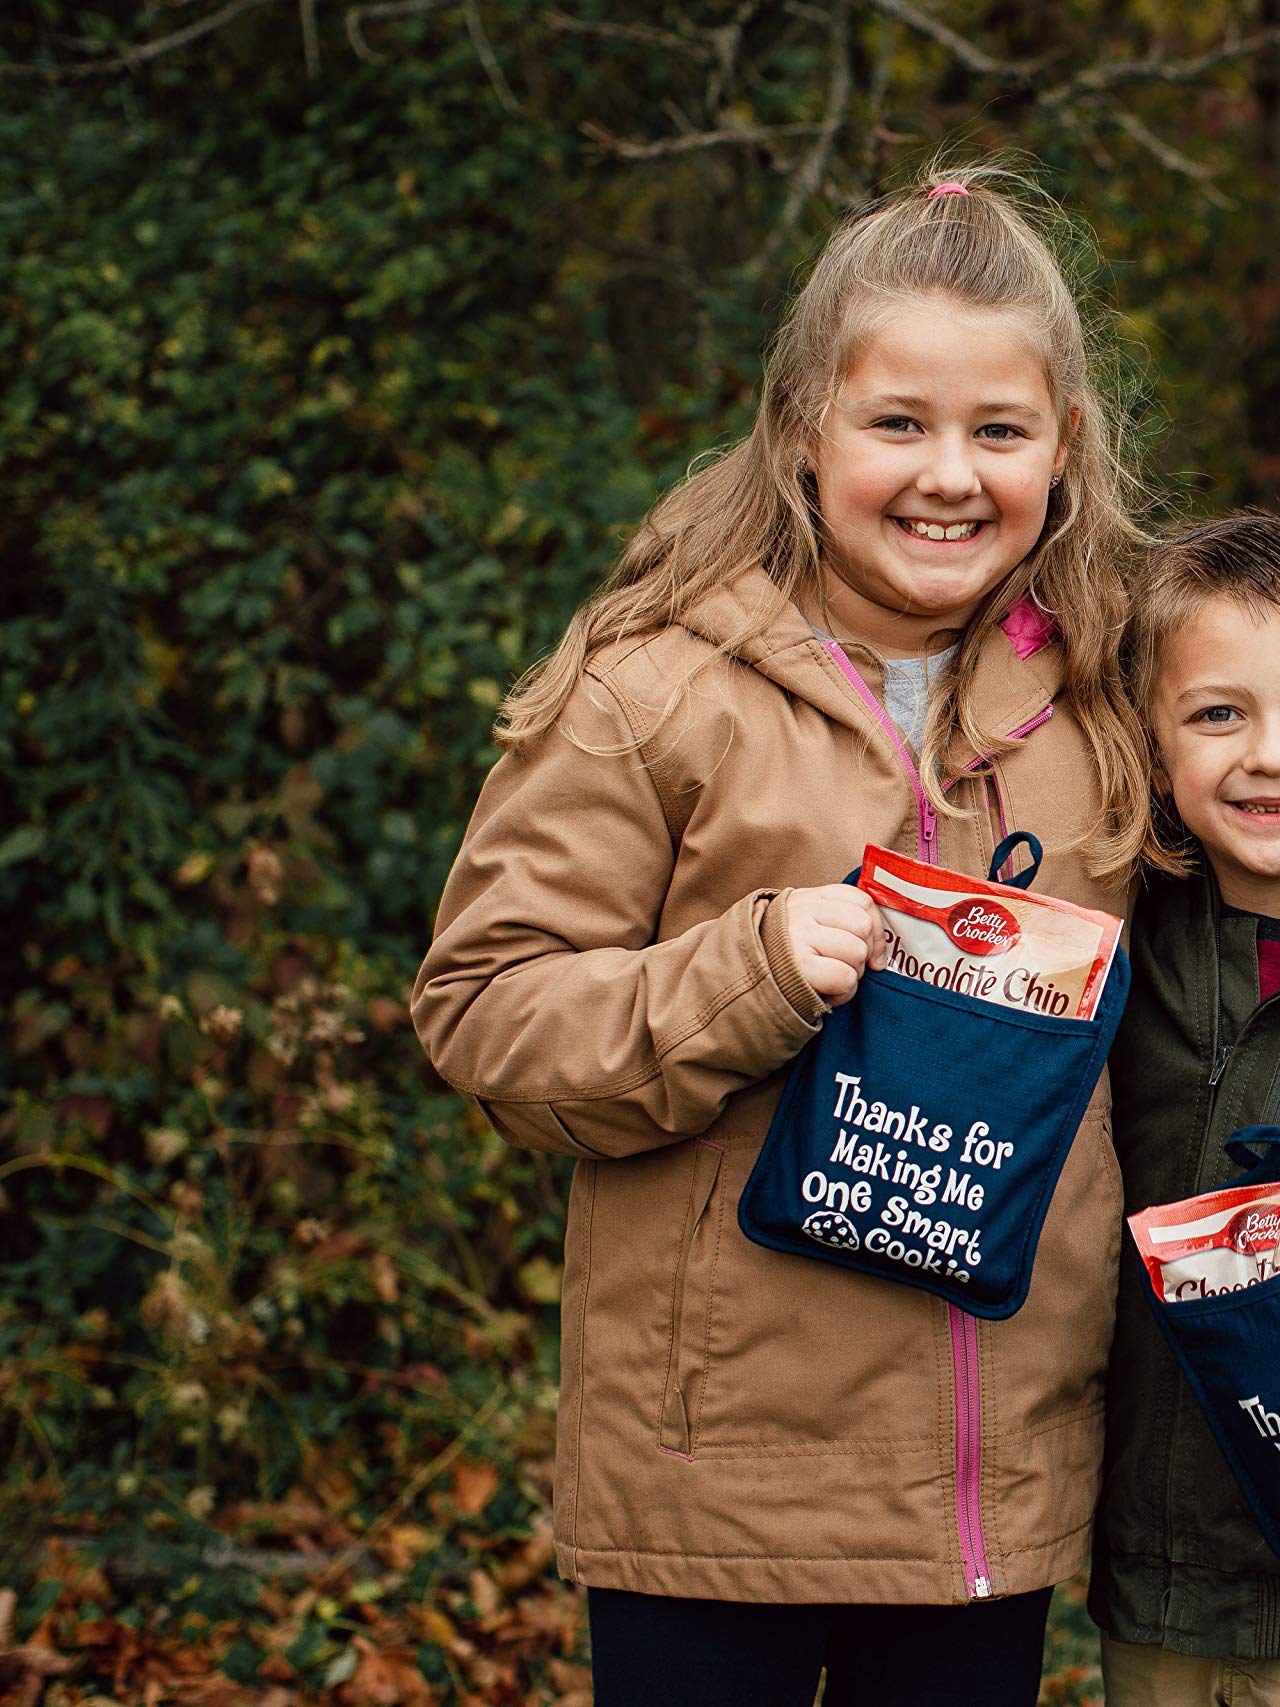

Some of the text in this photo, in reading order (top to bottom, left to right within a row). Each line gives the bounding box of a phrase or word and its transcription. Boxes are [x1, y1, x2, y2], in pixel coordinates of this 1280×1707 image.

[952, 918, 1013, 948] Crocker
[967, 906, 1006, 933] Betty
[1003, 967, 1069, 1016] Chip
[833, 1071, 1014, 1170] Thanks for
[829, 1128, 985, 1211] Making Me
[801, 1170, 982, 1266] One Smart
[864, 1227, 970, 1283] Cookie
